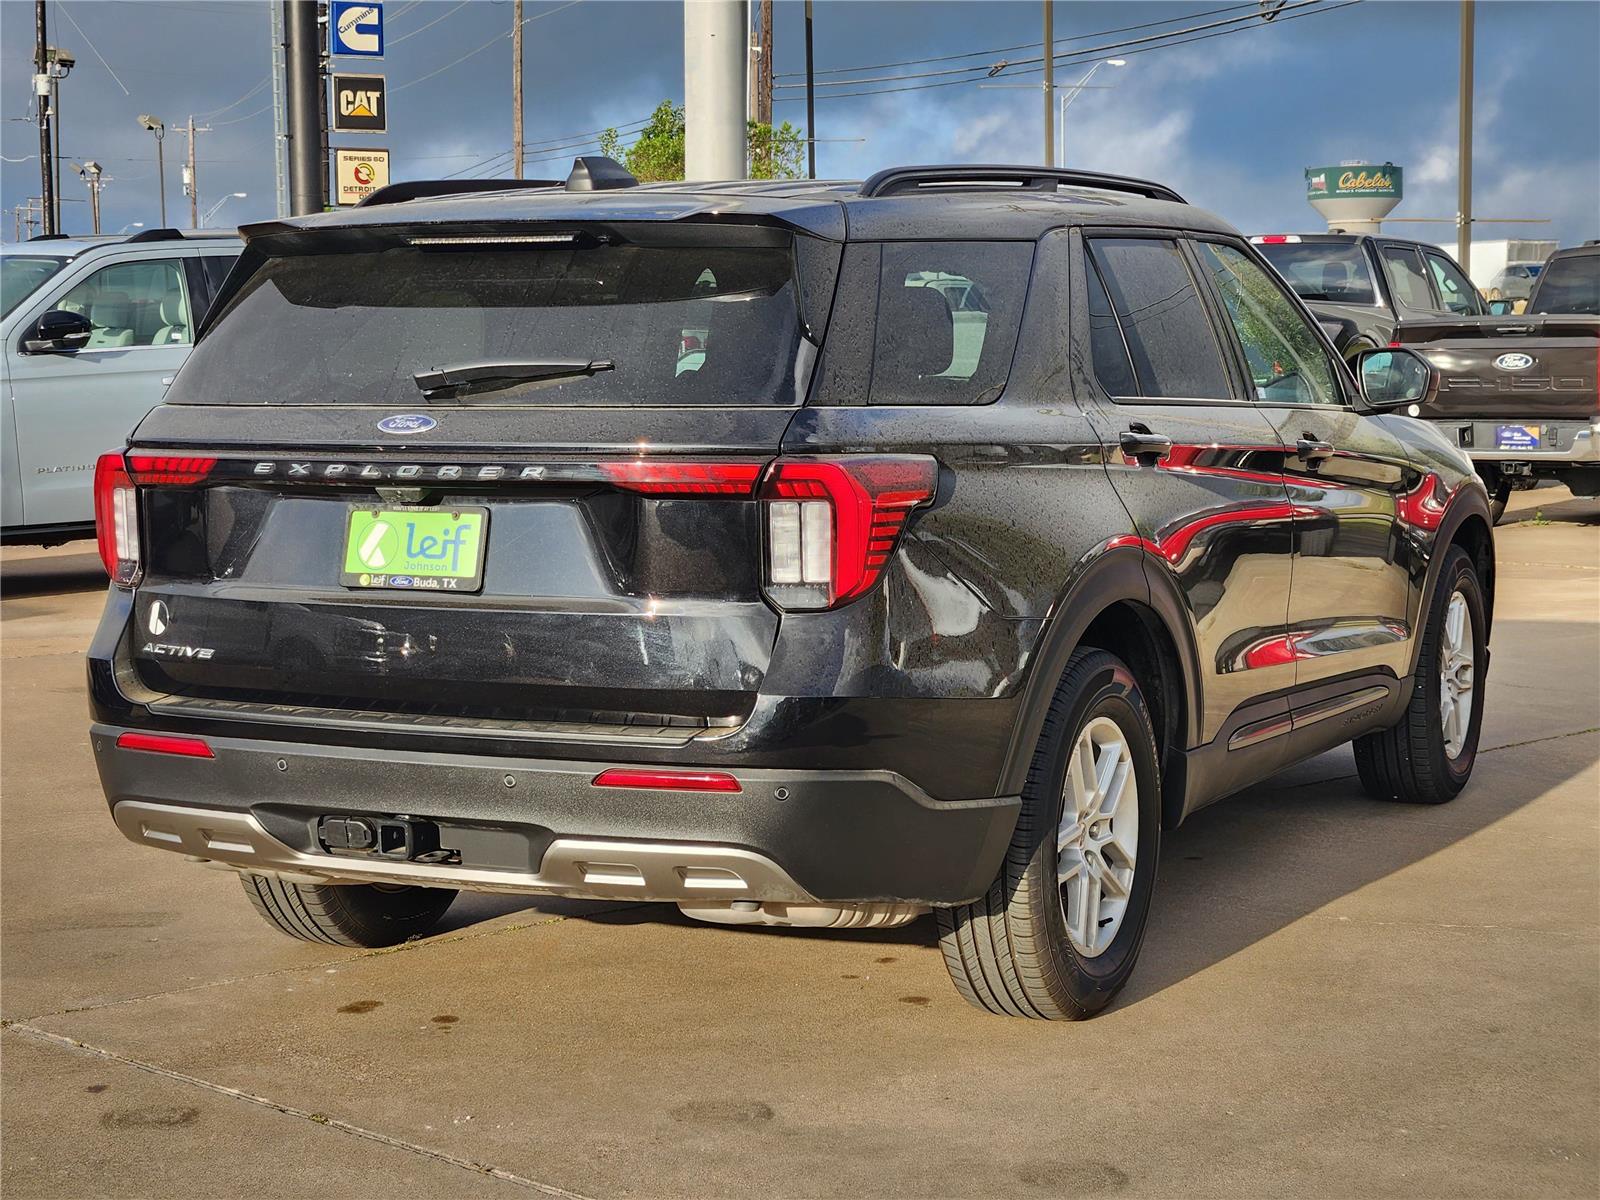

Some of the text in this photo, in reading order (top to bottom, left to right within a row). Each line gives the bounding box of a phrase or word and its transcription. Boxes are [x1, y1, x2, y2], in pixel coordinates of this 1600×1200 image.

[338, 8, 374, 33] Cummins
[340, 90, 381, 117] CAT
[1440, 375, 1593, 391] F-150
[254, 462, 546, 481] EXPLORER
[406, 522, 471, 573] leif
[403, 561, 448, 571] Johnson
[370, 574, 387, 586] leif
[413, 577, 440, 588] Buda,
[442, 578, 458, 589] TX
[143, 642, 216, 660] ACTIVE
